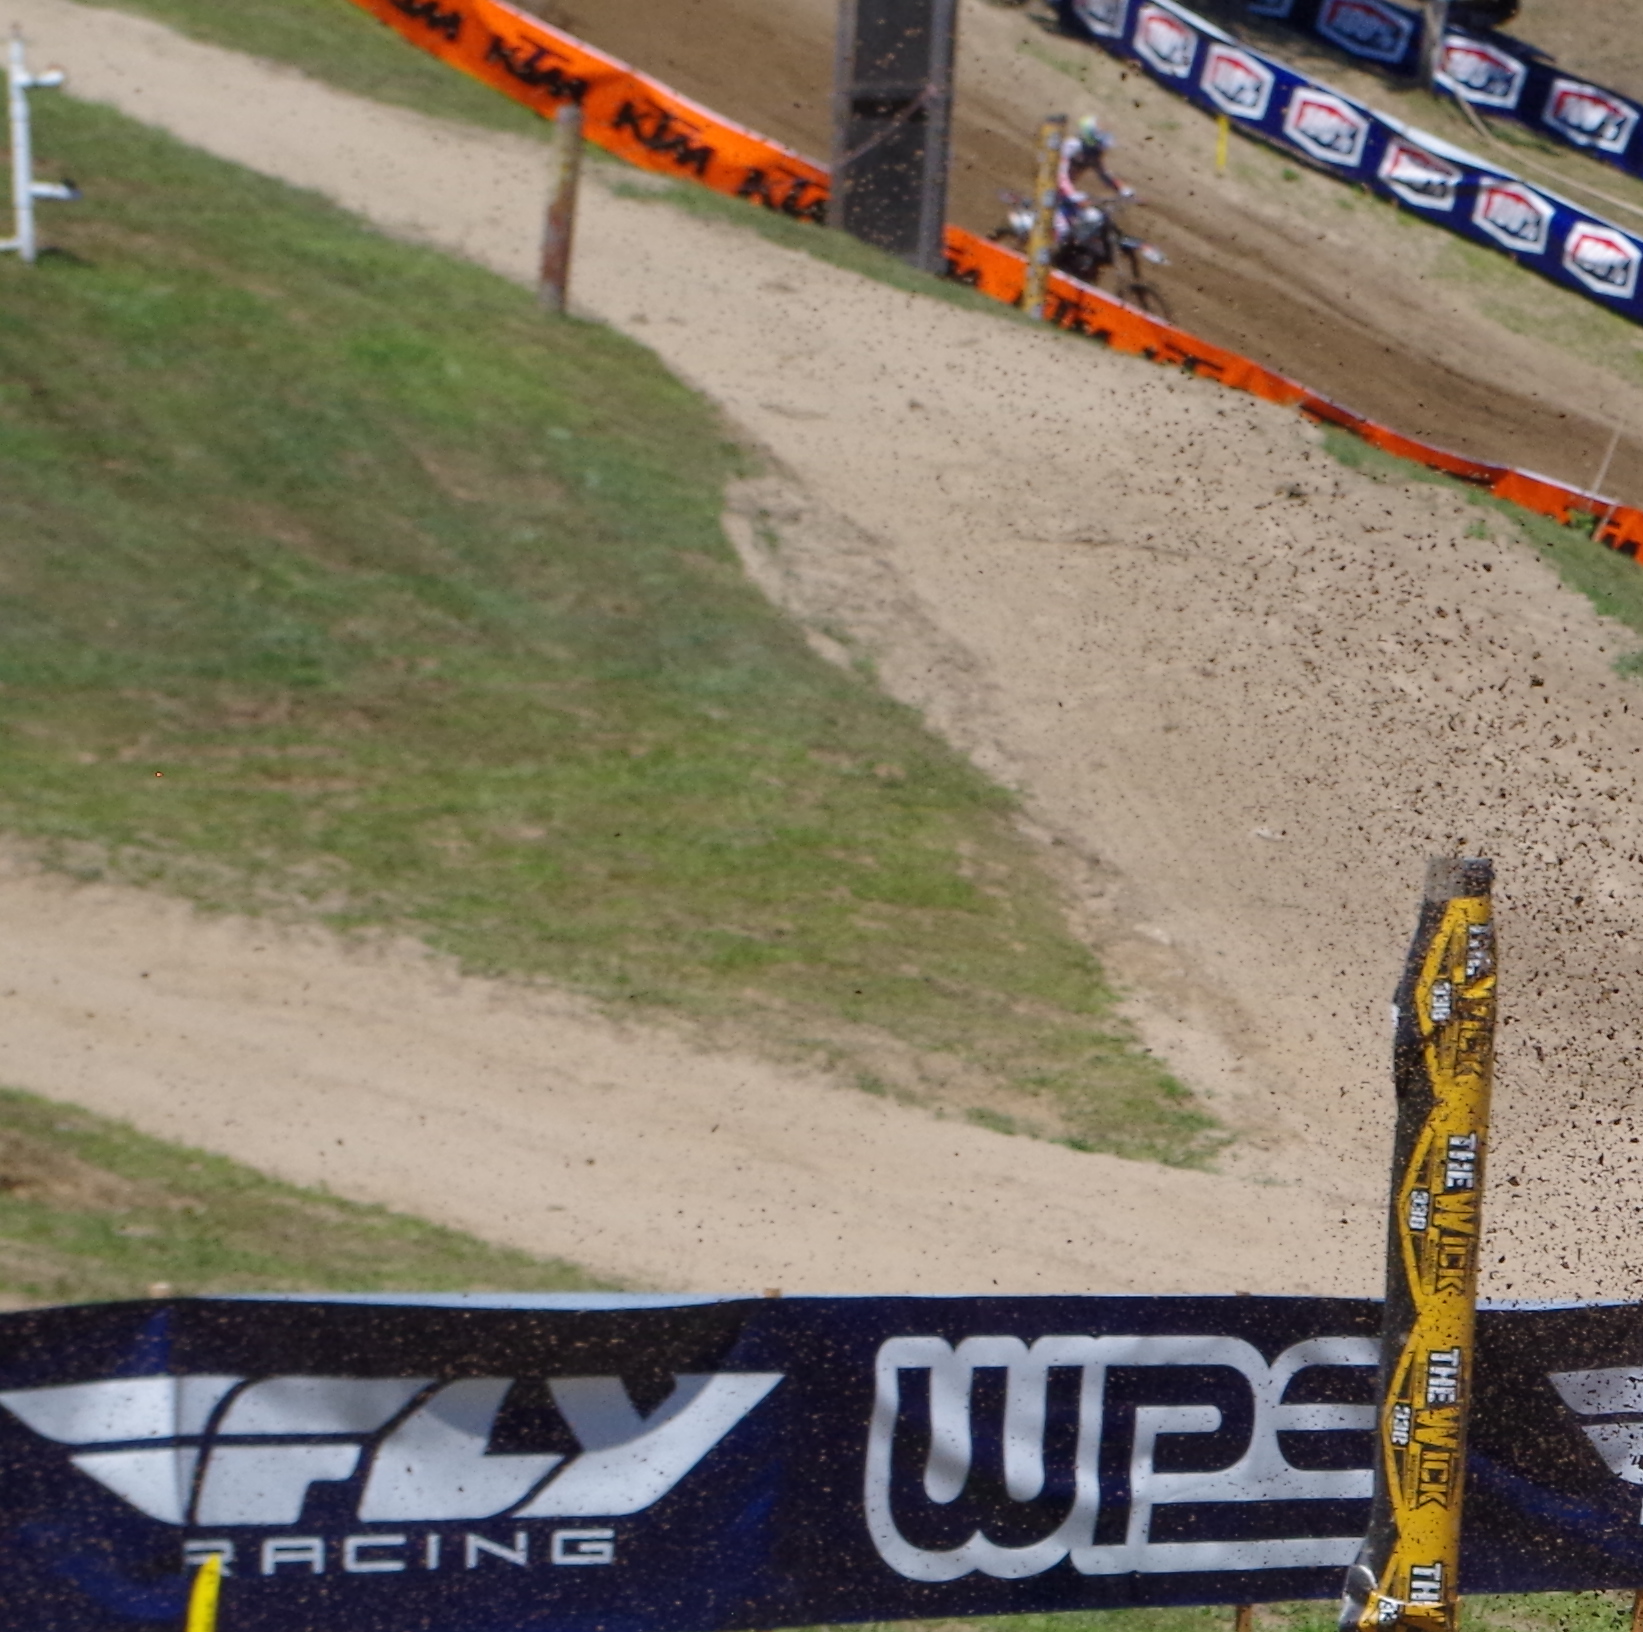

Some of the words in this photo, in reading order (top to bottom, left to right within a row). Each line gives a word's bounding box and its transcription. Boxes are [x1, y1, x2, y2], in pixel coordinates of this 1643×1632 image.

[485, 33, 588, 102] KTM
[611, 96, 715, 175] KTM
[1446, 1133, 1478, 1190] THE
[1432, 1191, 1478, 1297] WICK
[1427, 1346, 1461, 1405] THE
[5, 1373, 787, 1526] FLY
[1414, 1406, 1460, 1510] WICK
[184, 1528, 616, 1577] RACING
